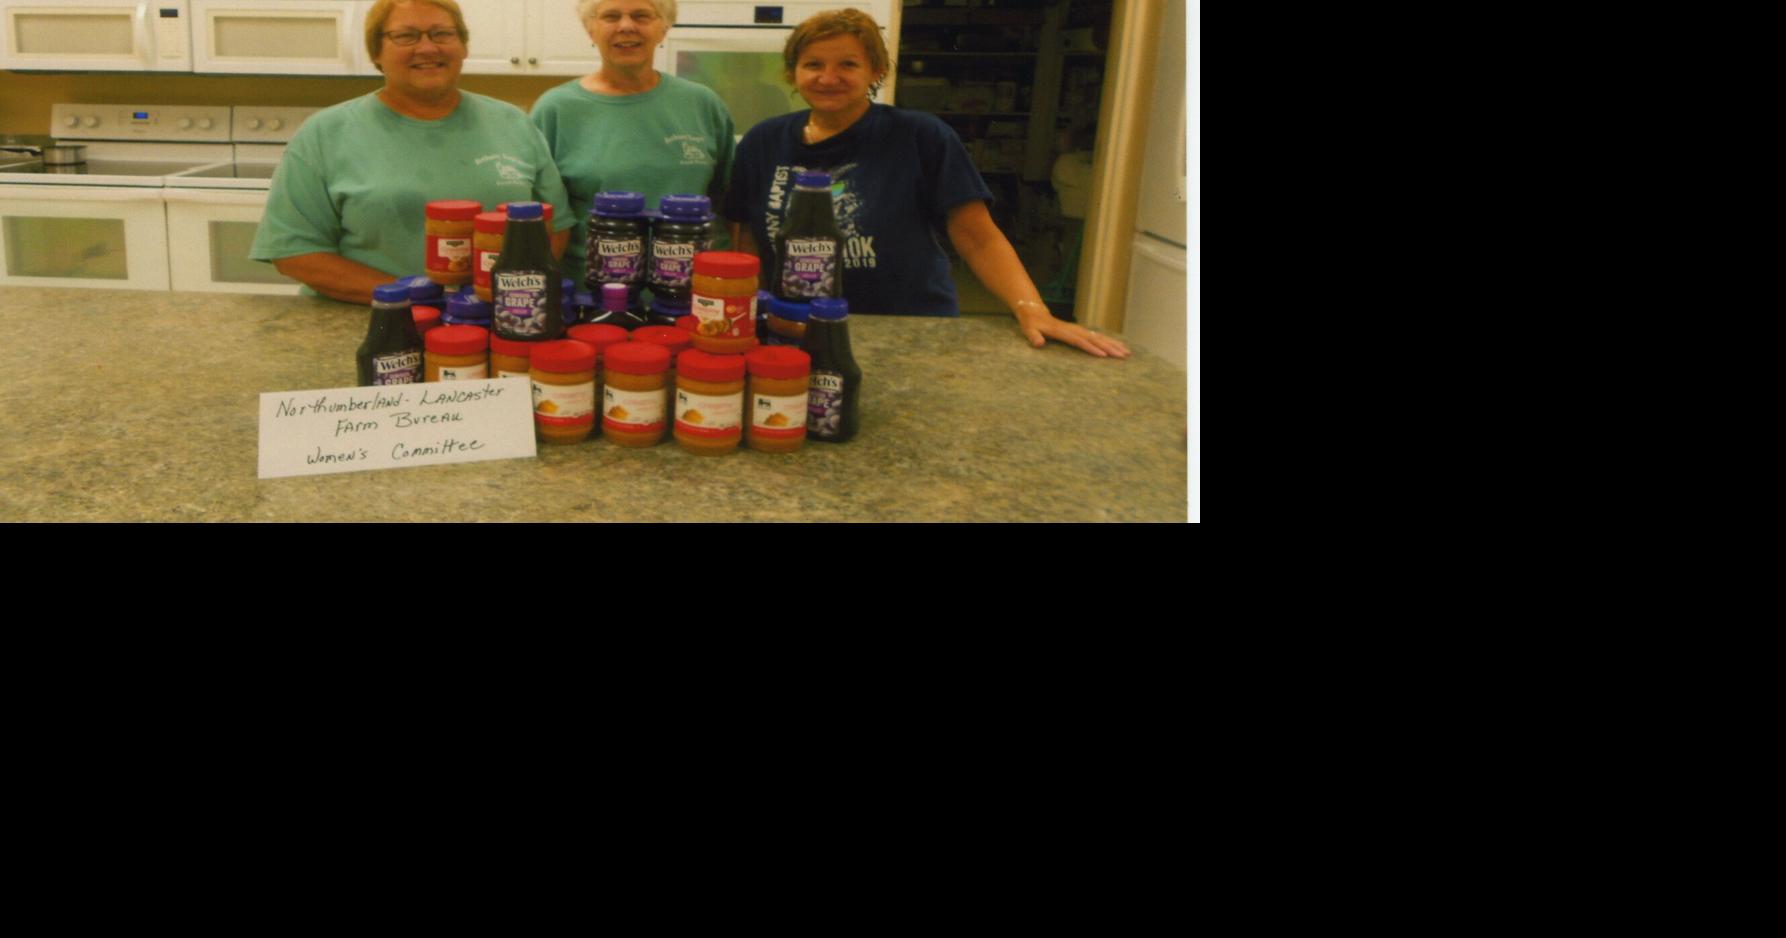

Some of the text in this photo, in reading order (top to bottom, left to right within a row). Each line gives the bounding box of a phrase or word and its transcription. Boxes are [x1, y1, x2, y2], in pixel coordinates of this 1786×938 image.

[765, 165, 790, 251] ANY BAPTIST
[655, 245, 692, 256] Welch's
[791, 242, 832, 254] Welch's
[794, 261, 825, 273] GRAPE
[844, 258, 877, 268] 2019
[500, 276, 542, 288] Welch's
[504, 296, 535, 308] GRAPE
[380, 354, 419, 371] Welch's
[812, 376, 838, 387] lch's
[391, 438, 485, 461] Committee
